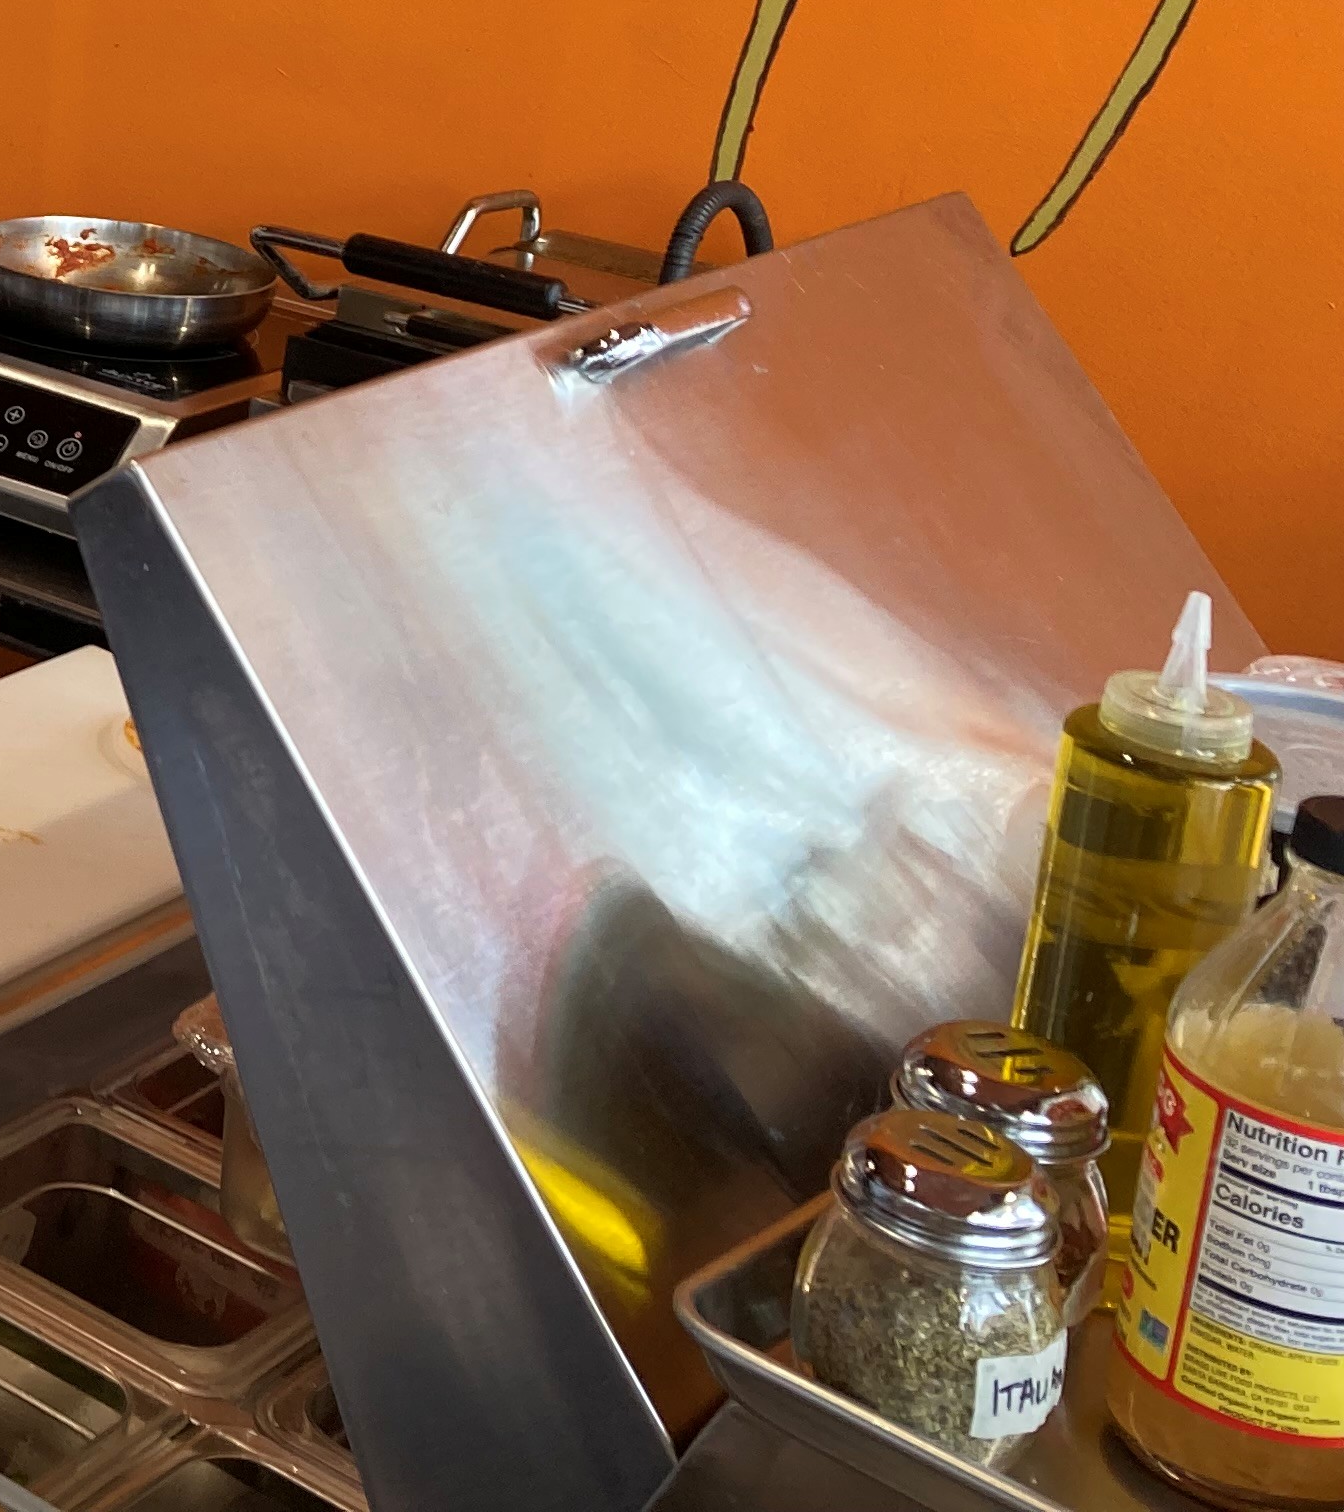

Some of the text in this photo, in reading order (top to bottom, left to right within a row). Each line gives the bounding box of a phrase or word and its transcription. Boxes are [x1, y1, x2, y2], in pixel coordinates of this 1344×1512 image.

[1226, 1111, 1329, 1164] Nutrition
[1240, 1143, 1290, 1170] servings
[1292, 1164, 1315, 1175] per
[1251, 1163, 1277, 1179] size
[1215, 1183, 1305, 1229] Calories
[1206, 1233, 1246, 1258] Sodium
[1209, 1219, 1234, 1237] Total
[1237, 1232, 1254, 1246] Fat
[1200, 1261, 1237, 1286] Protein
[1203, 1246, 1229, 1267] Total
[1230, 1261, 1308, 1293] Carbohydrate
